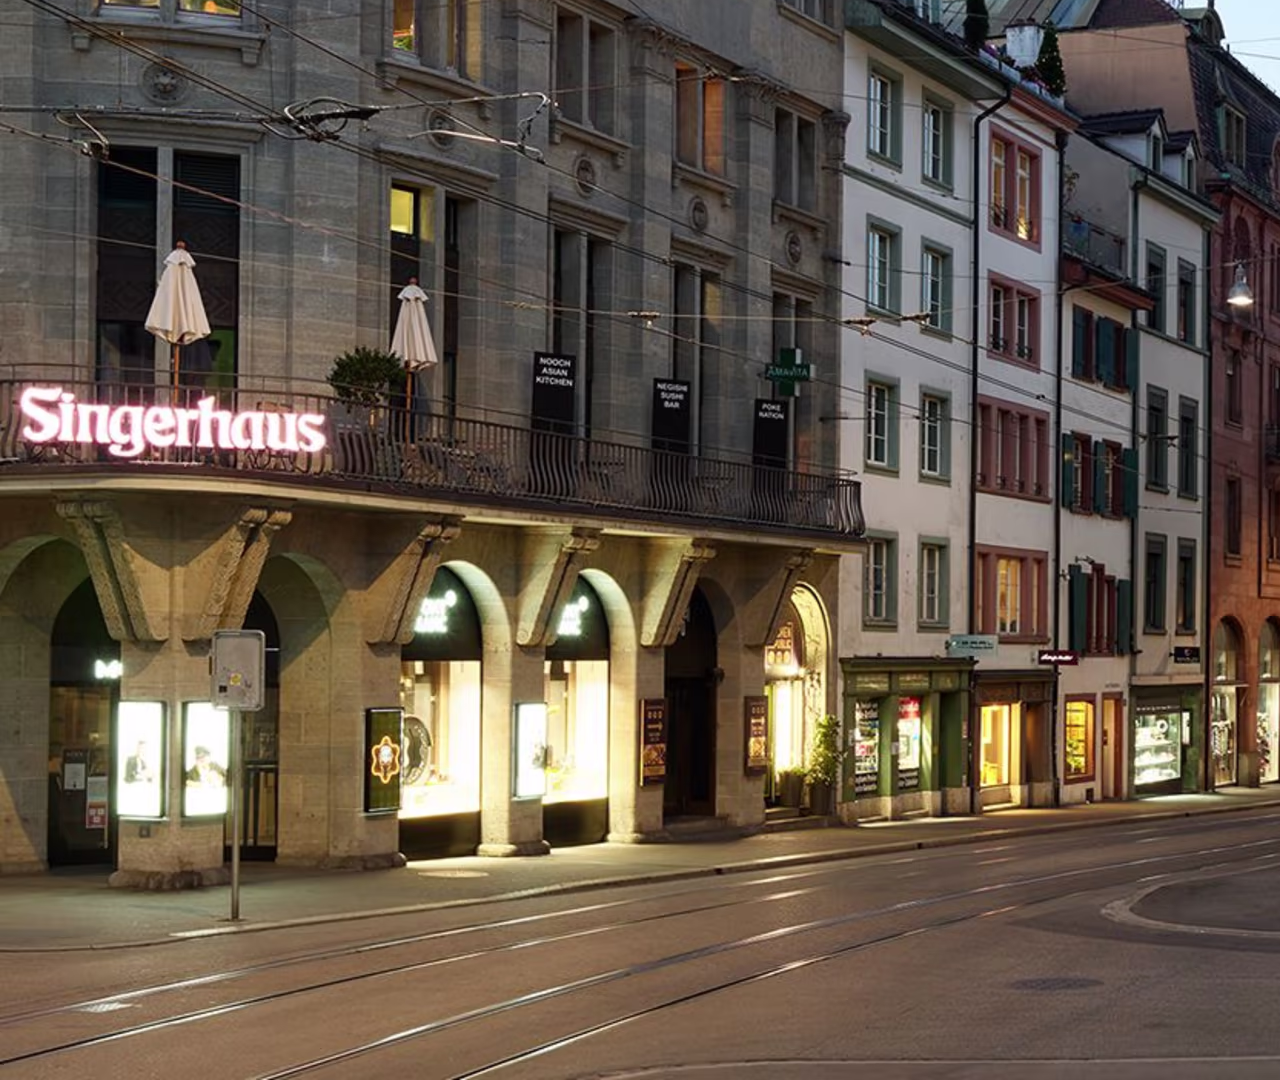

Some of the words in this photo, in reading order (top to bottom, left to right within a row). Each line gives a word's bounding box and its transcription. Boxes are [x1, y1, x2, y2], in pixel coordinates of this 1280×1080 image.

[539, 357, 571, 367] NOOCH
[541, 366, 568, 376] ASIAN
[536, 375, 573, 386] KITCHEN
[656, 382, 688, 392] NEGISHI
[660, 391, 684, 400] SUSHI
[664, 400, 680, 409] BAR
[762, 402, 781, 412] POKE
[759, 411, 785, 420] NATION
[20, 386, 326, 457] Singerhaus
